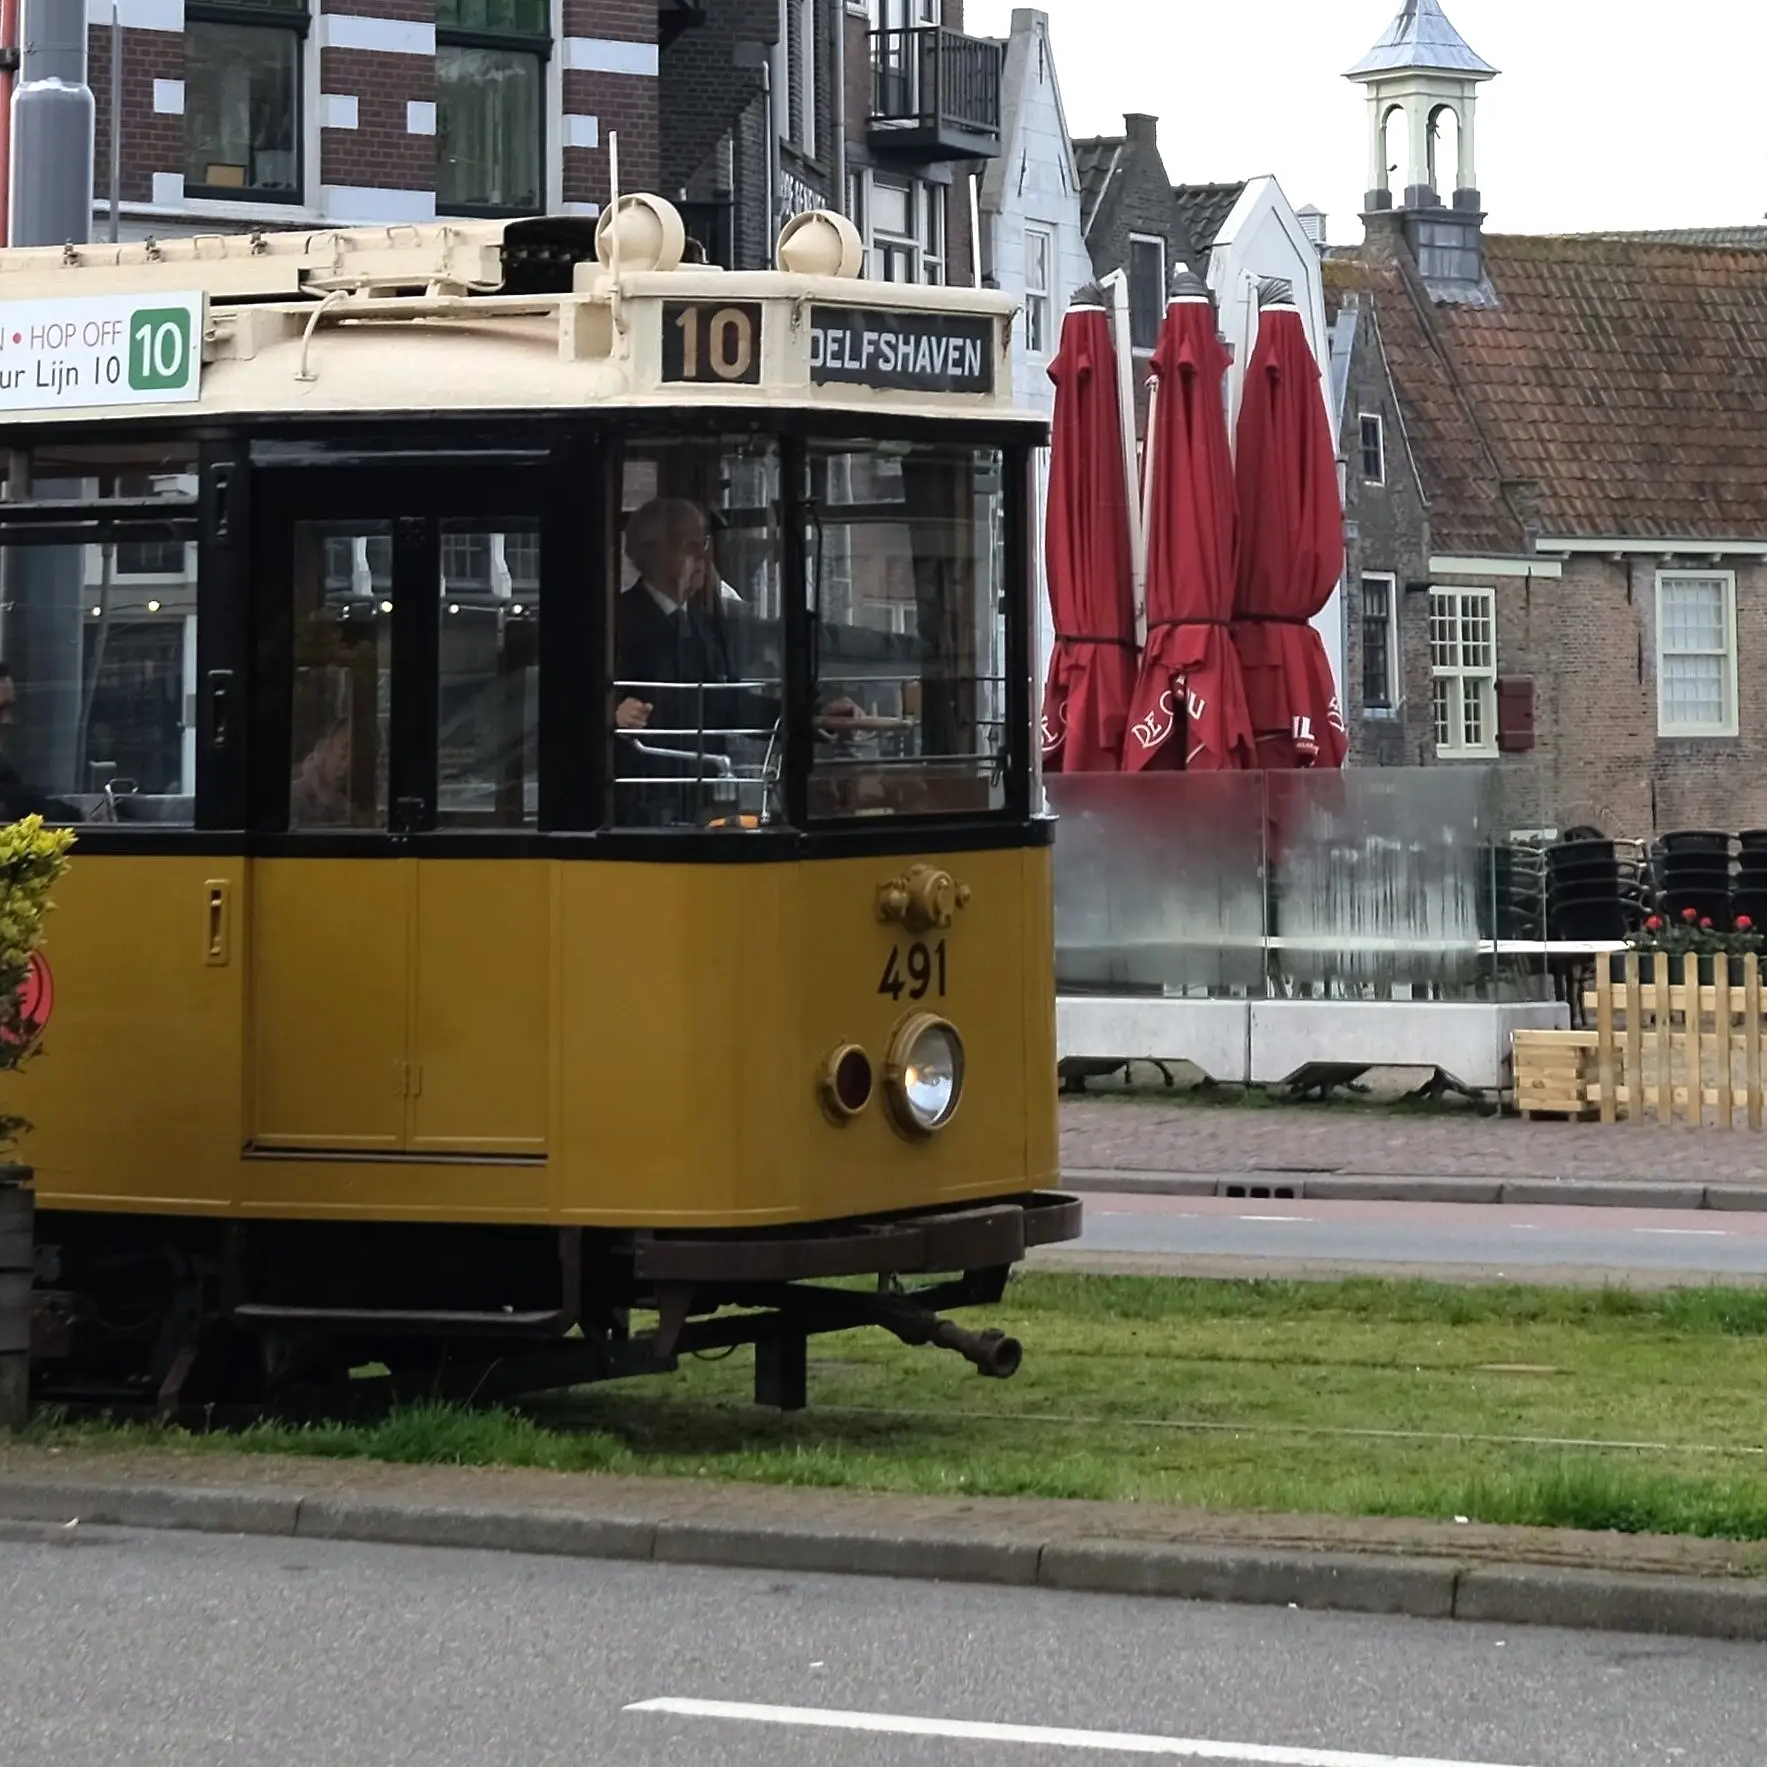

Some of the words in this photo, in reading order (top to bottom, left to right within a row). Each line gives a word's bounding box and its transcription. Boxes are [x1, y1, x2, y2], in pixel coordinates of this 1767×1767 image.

[31, 323, 76, 349] HOP
[83, 321, 122, 347] OFF
[135, 321, 183, 378] 10
[676, 306, 752, 379] 10
[810, 328, 981, 377] DELFSHAVEN
[36, 360, 78, 395] Lijn
[95, 356, 120, 384] 10
[877, 938, 947, 1001] 491
